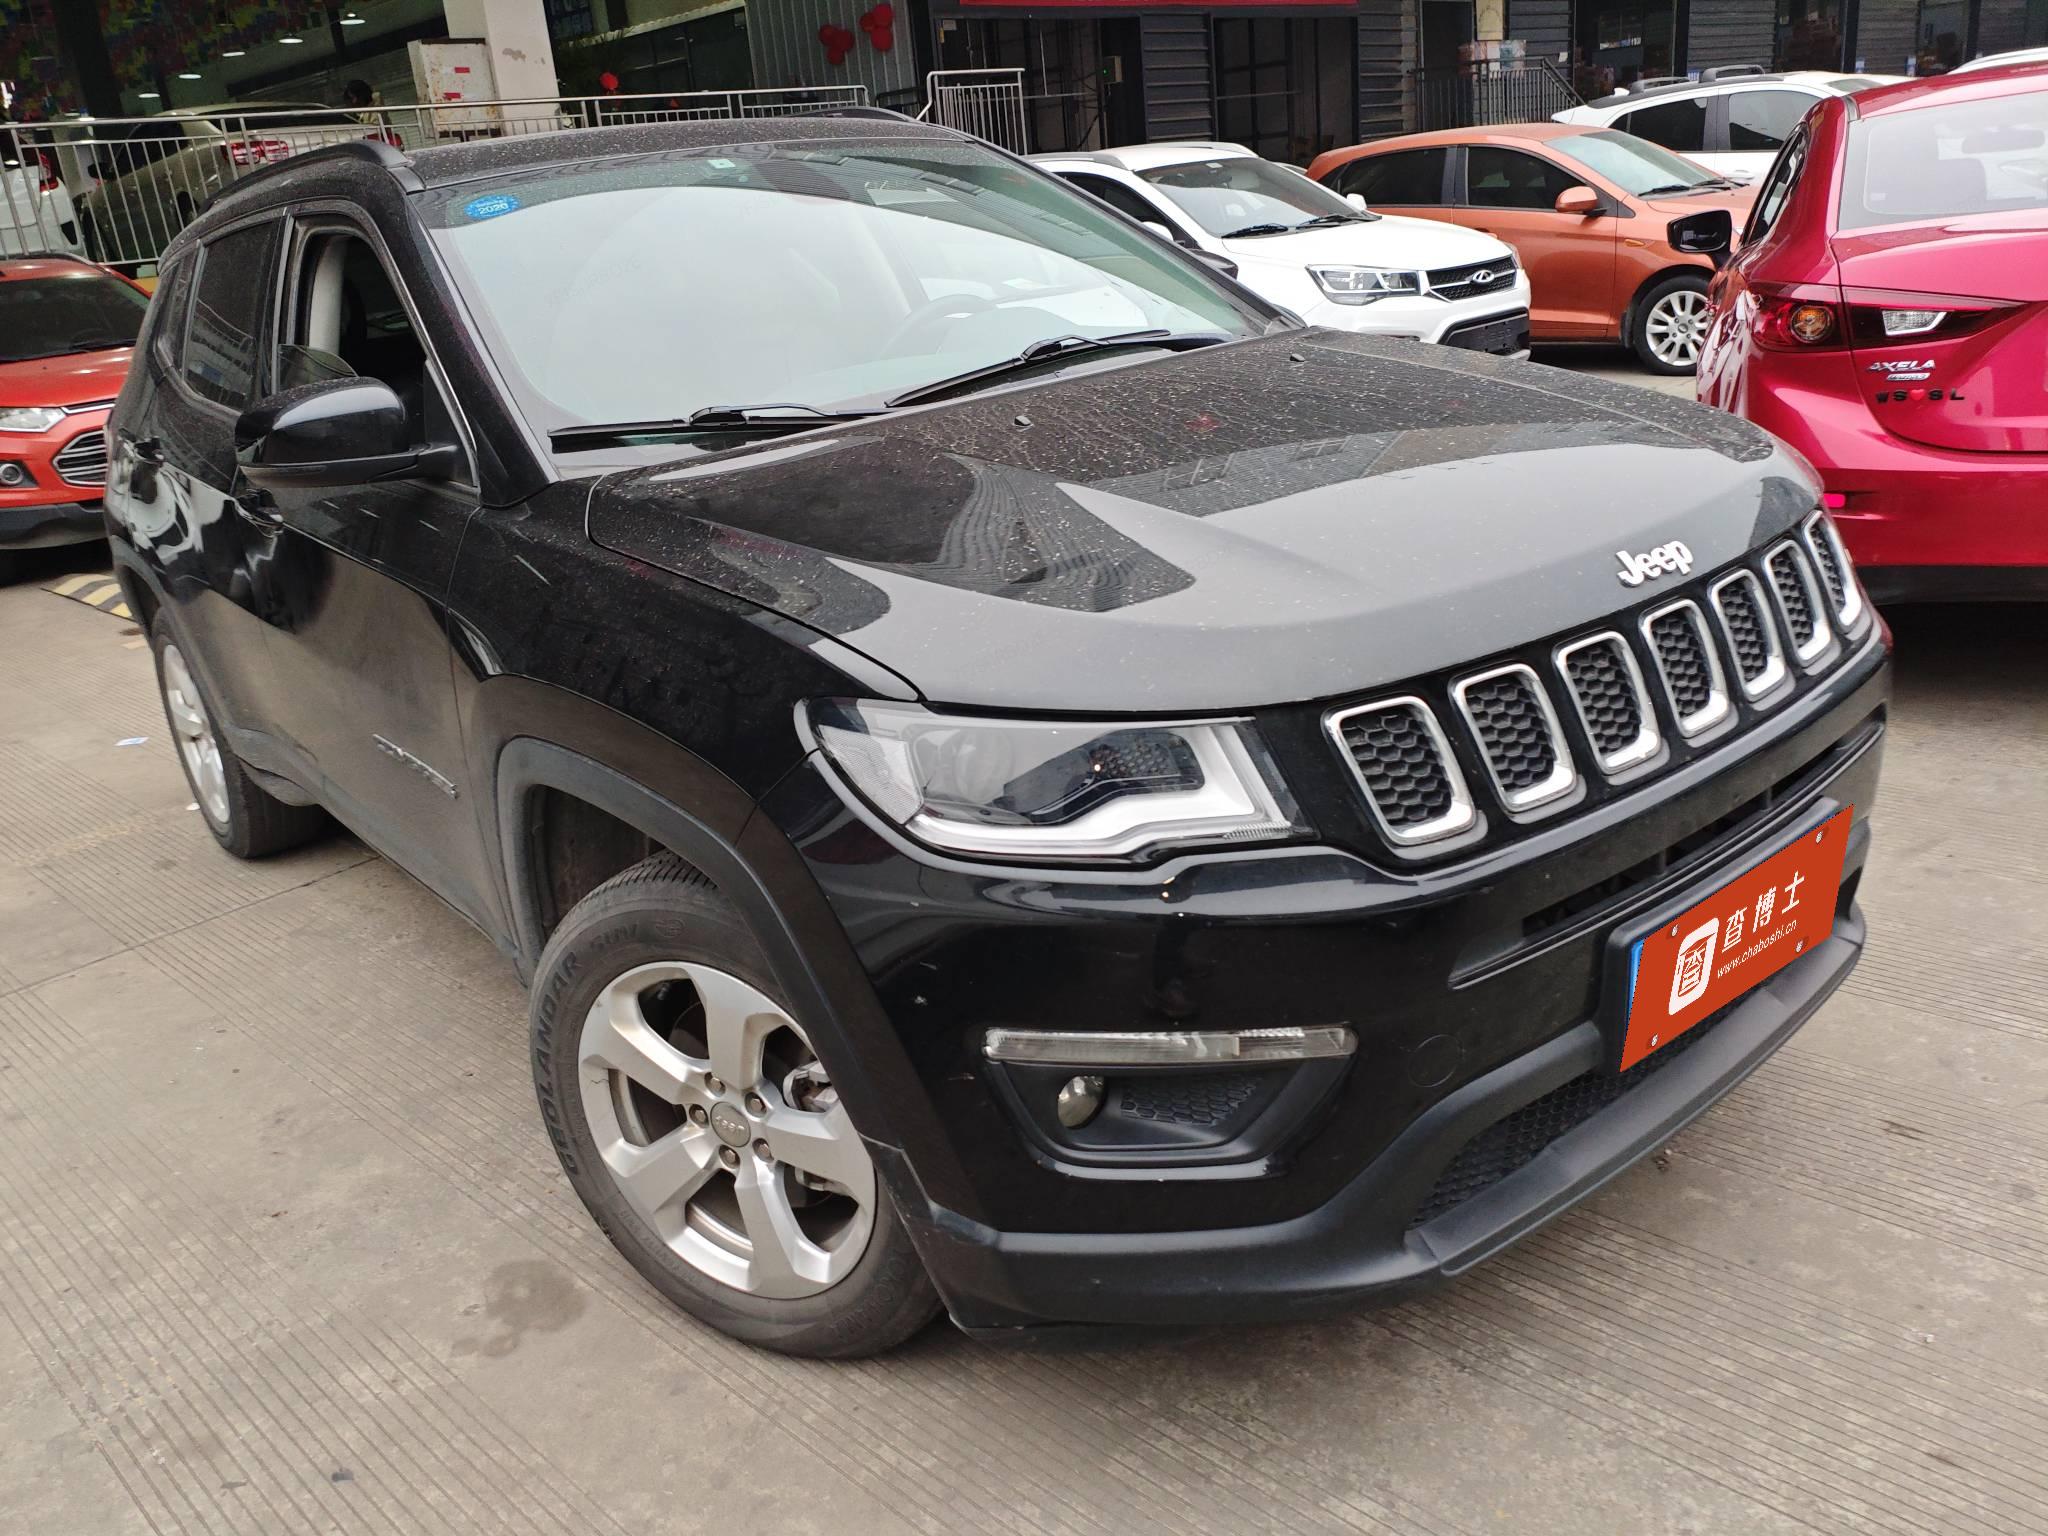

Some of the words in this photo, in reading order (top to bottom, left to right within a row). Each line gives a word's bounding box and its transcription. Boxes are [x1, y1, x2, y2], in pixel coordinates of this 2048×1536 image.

[478, 202, 510, 215] 2020
[1867, 360, 1936, 371] AXELA
[1615, 540, 1694, 587] Jeep
